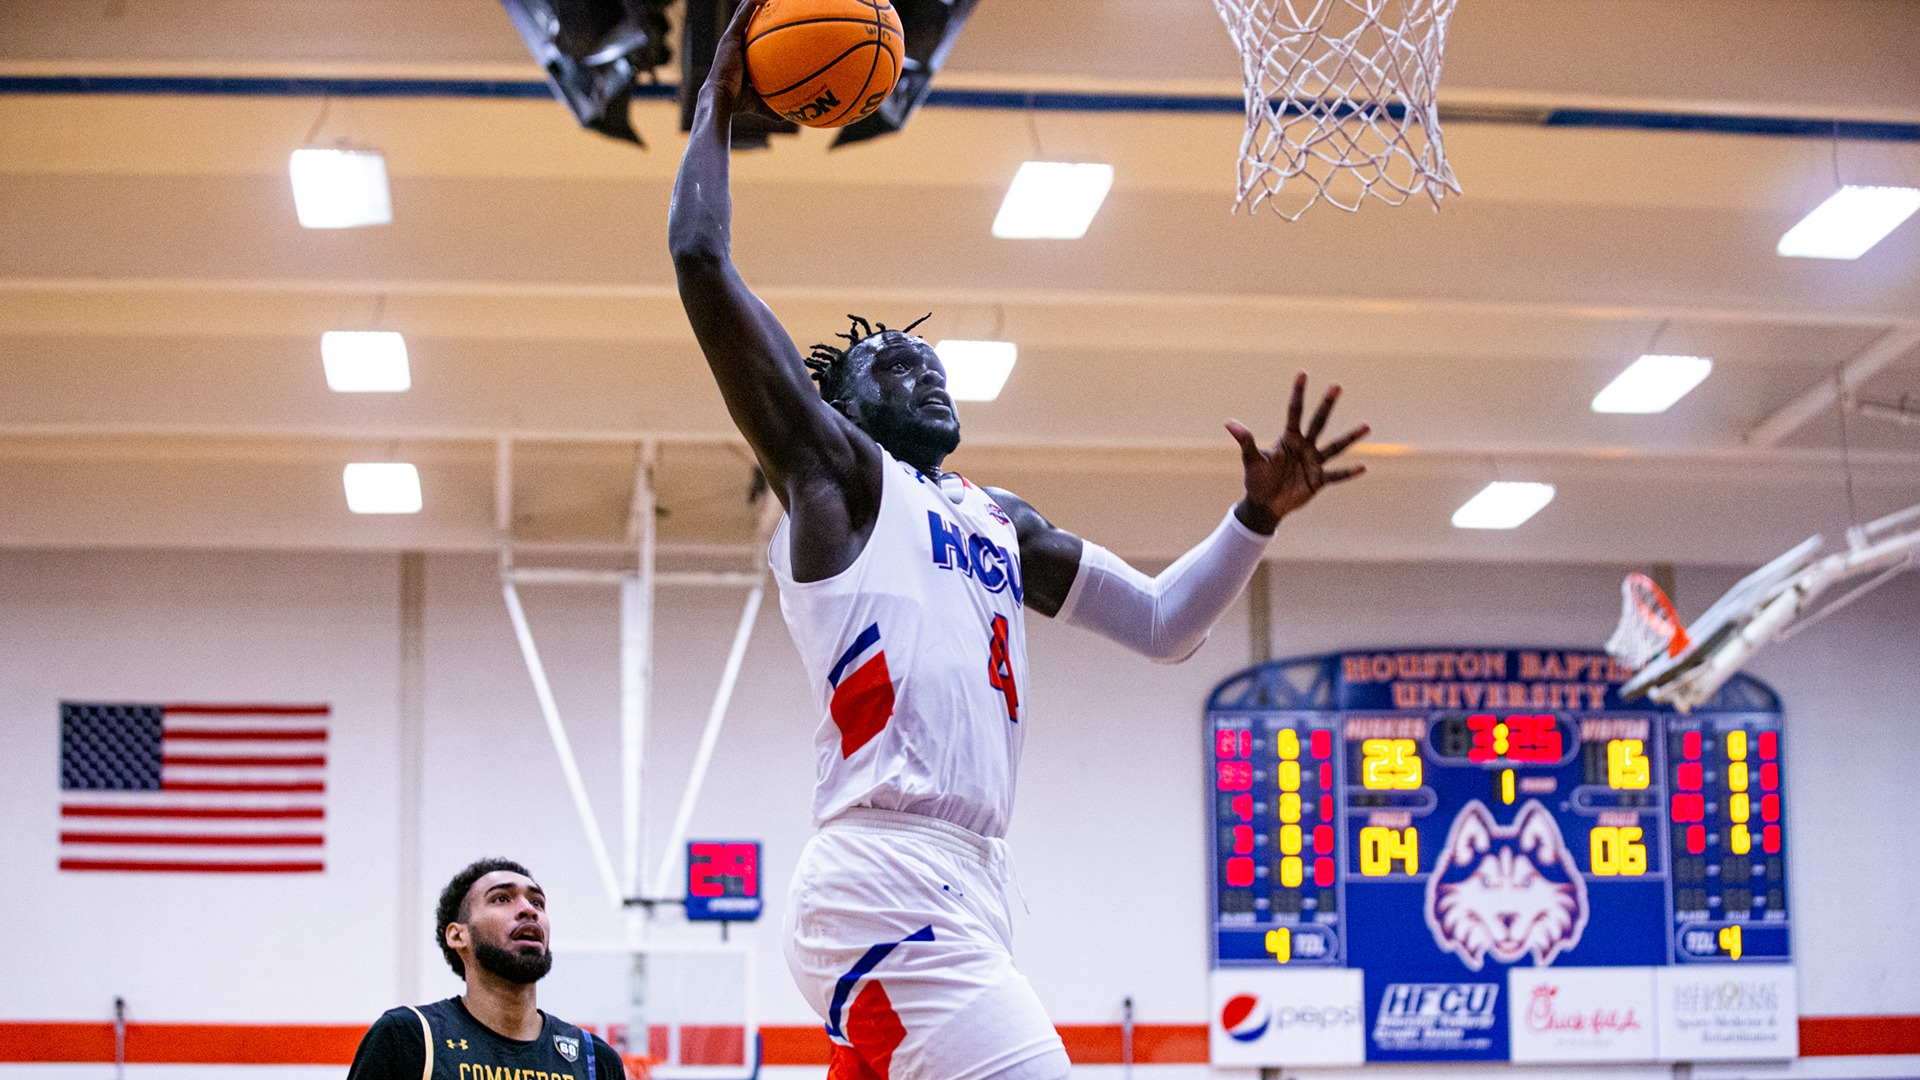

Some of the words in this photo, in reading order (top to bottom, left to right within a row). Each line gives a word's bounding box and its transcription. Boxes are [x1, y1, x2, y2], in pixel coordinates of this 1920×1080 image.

[927, 509, 1024, 609] HCU
[988, 611, 1019, 723] 4
[1344, 654, 1506, 682] HOUSTON
[1519, 654, 1635, 681] BAPTI
[1392, 681, 1606, 709] UNIVERSITY
[1467, 714, 1563, 763] 3:25
[1362, 739, 1422, 790] 25
[1501, 769, 1515, 805] 1
[1607, 739, 1650, 790] 15
[690, 842, 757, 897] 29
[1360, 826, 1419, 877] 04
[1590, 826, 1647, 876] 06
[1387, 984, 1495, 1015] HFCU
[459, 1063, 576, 1080] COMME
